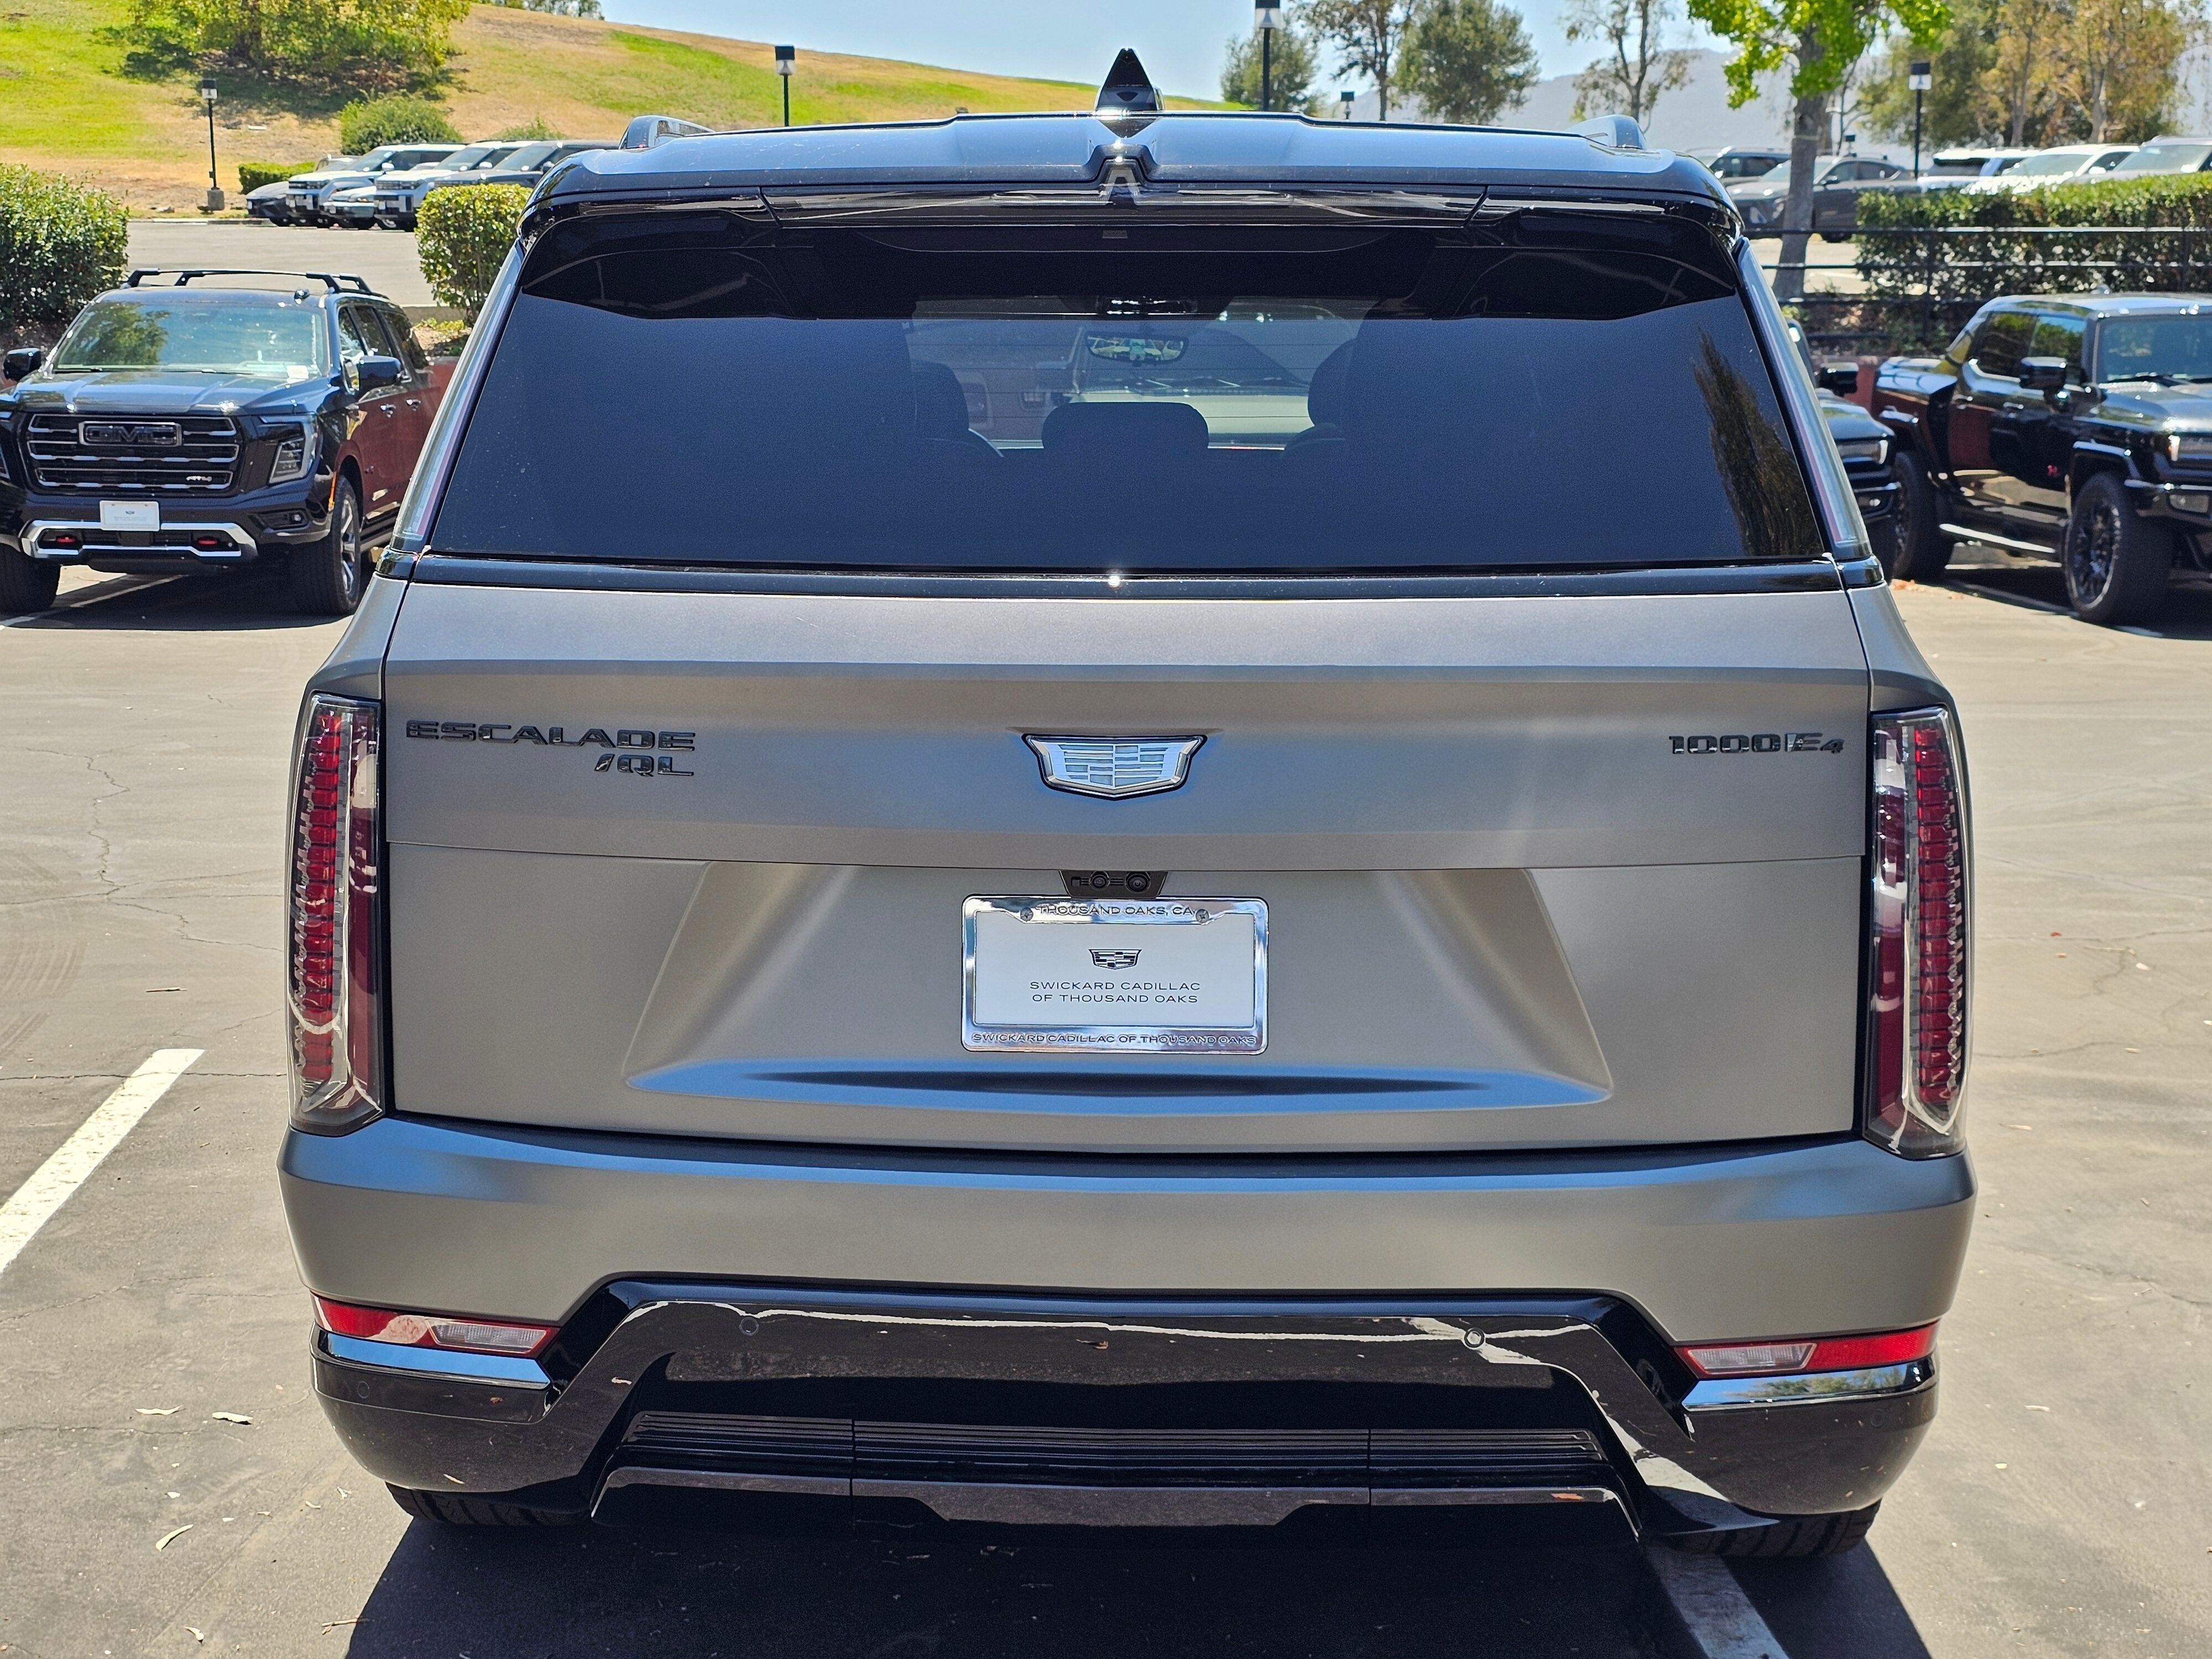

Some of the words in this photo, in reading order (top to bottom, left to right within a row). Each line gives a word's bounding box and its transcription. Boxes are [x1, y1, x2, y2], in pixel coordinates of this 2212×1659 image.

[85, 425, 176, 444] GMC
[406, 720, 696, 751] ESCALADE
[1037, 905, 1121, 915] THOUSAND
[1124, 905, 1168, 917] OAKS,
[1172, 905, 1194, 915] CA
[1030, 982, 1115, 990] SWICKARD
[1120, 982, 1201, 990] CADILLAC
[1059, 994, 1149, 1003] THOUSAND
[1155, 995, 1198, 1003] OAKS
[973, 1033, 1045, 1042] SWICKARD
[1048, 1034, 1115, 1043] CADILLAC
[1119, 1035, 1136, 1043] OF
[1140, 1035, 1217, 1044] THOUSAND
[1219, 1035, 1257, 1045] OAKS
